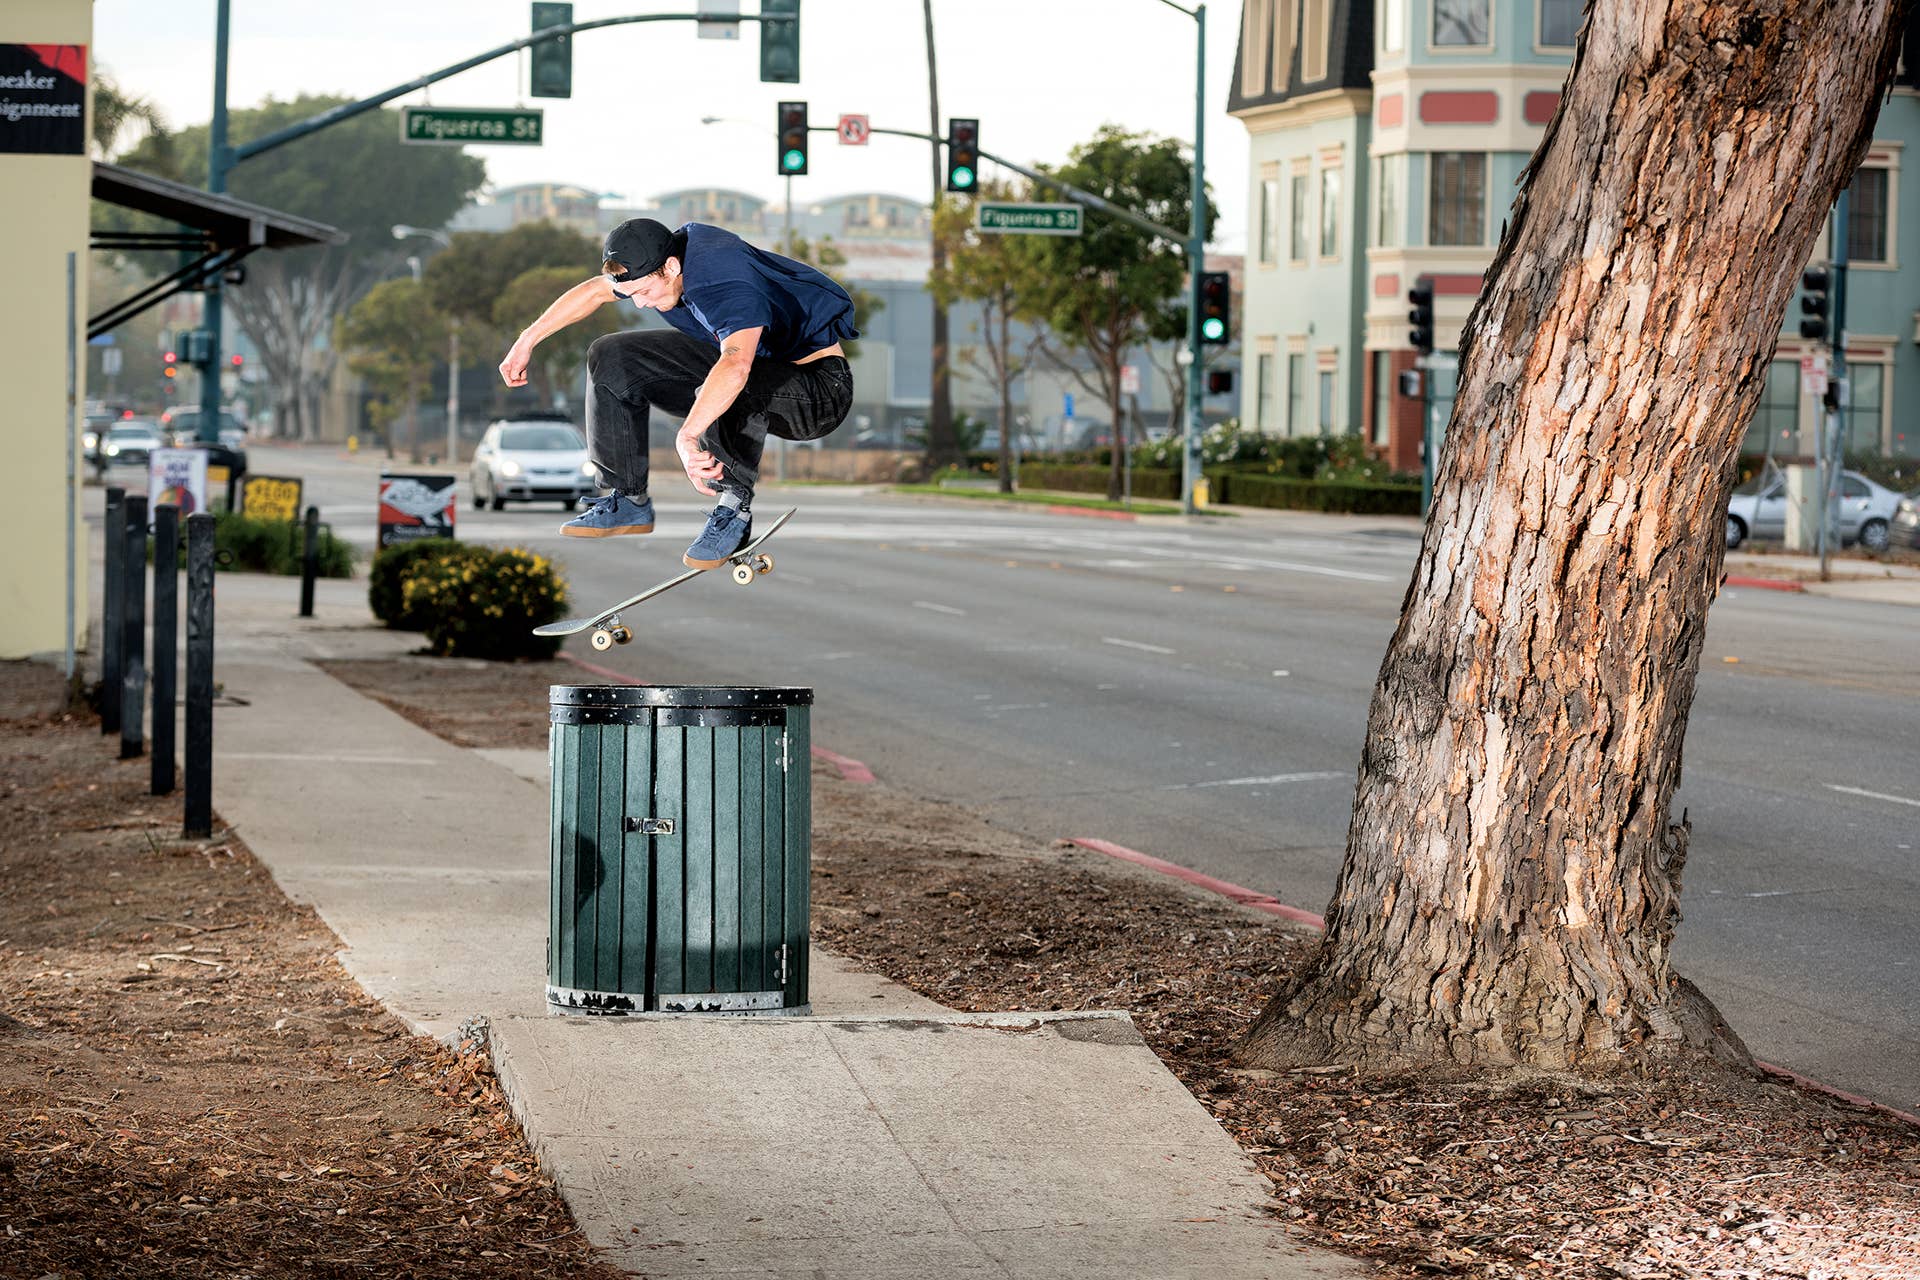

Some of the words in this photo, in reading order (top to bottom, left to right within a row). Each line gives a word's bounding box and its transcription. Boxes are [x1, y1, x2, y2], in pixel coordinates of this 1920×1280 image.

[411, 115, 506, 139] Figueroa
[511, 117, 537, 138] St
[983, 209, 1053, 228] Figueroa
[1056, 211, 1075, 227] St
